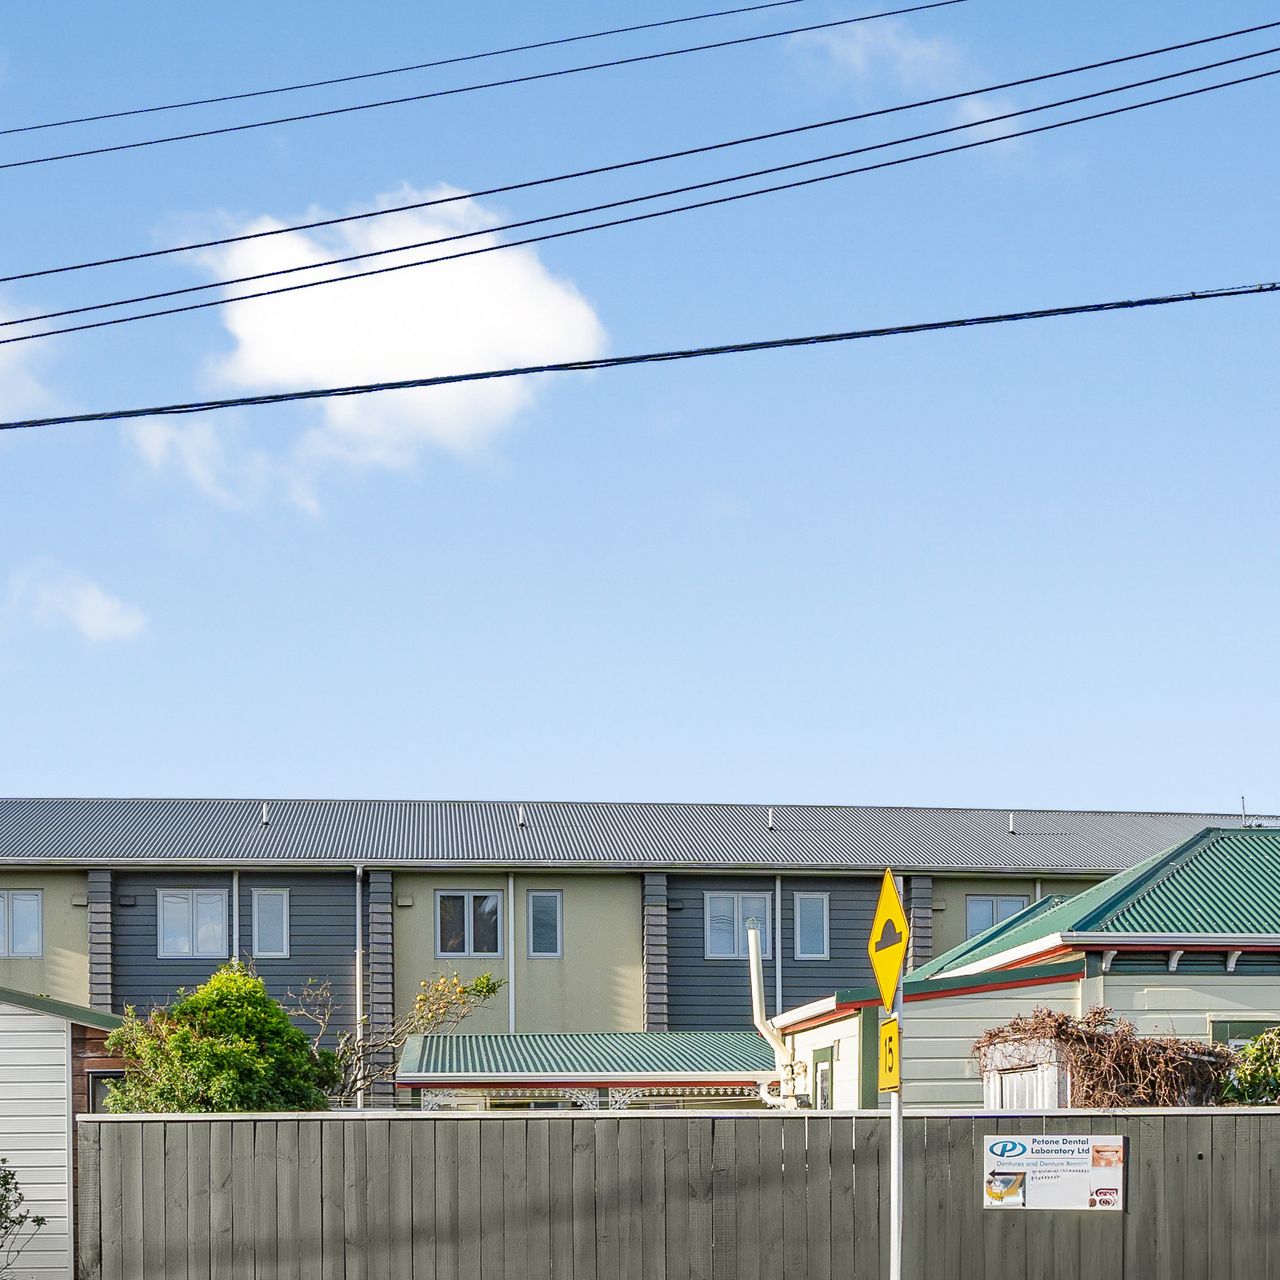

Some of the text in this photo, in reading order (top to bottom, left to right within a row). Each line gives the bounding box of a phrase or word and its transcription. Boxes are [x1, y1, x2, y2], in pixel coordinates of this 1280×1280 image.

[884, 1036, 894, 1074] 15
[1062, 1137, 1089, 1145] Dental
[1031, 1147, 1075, 1155] Laboratory
